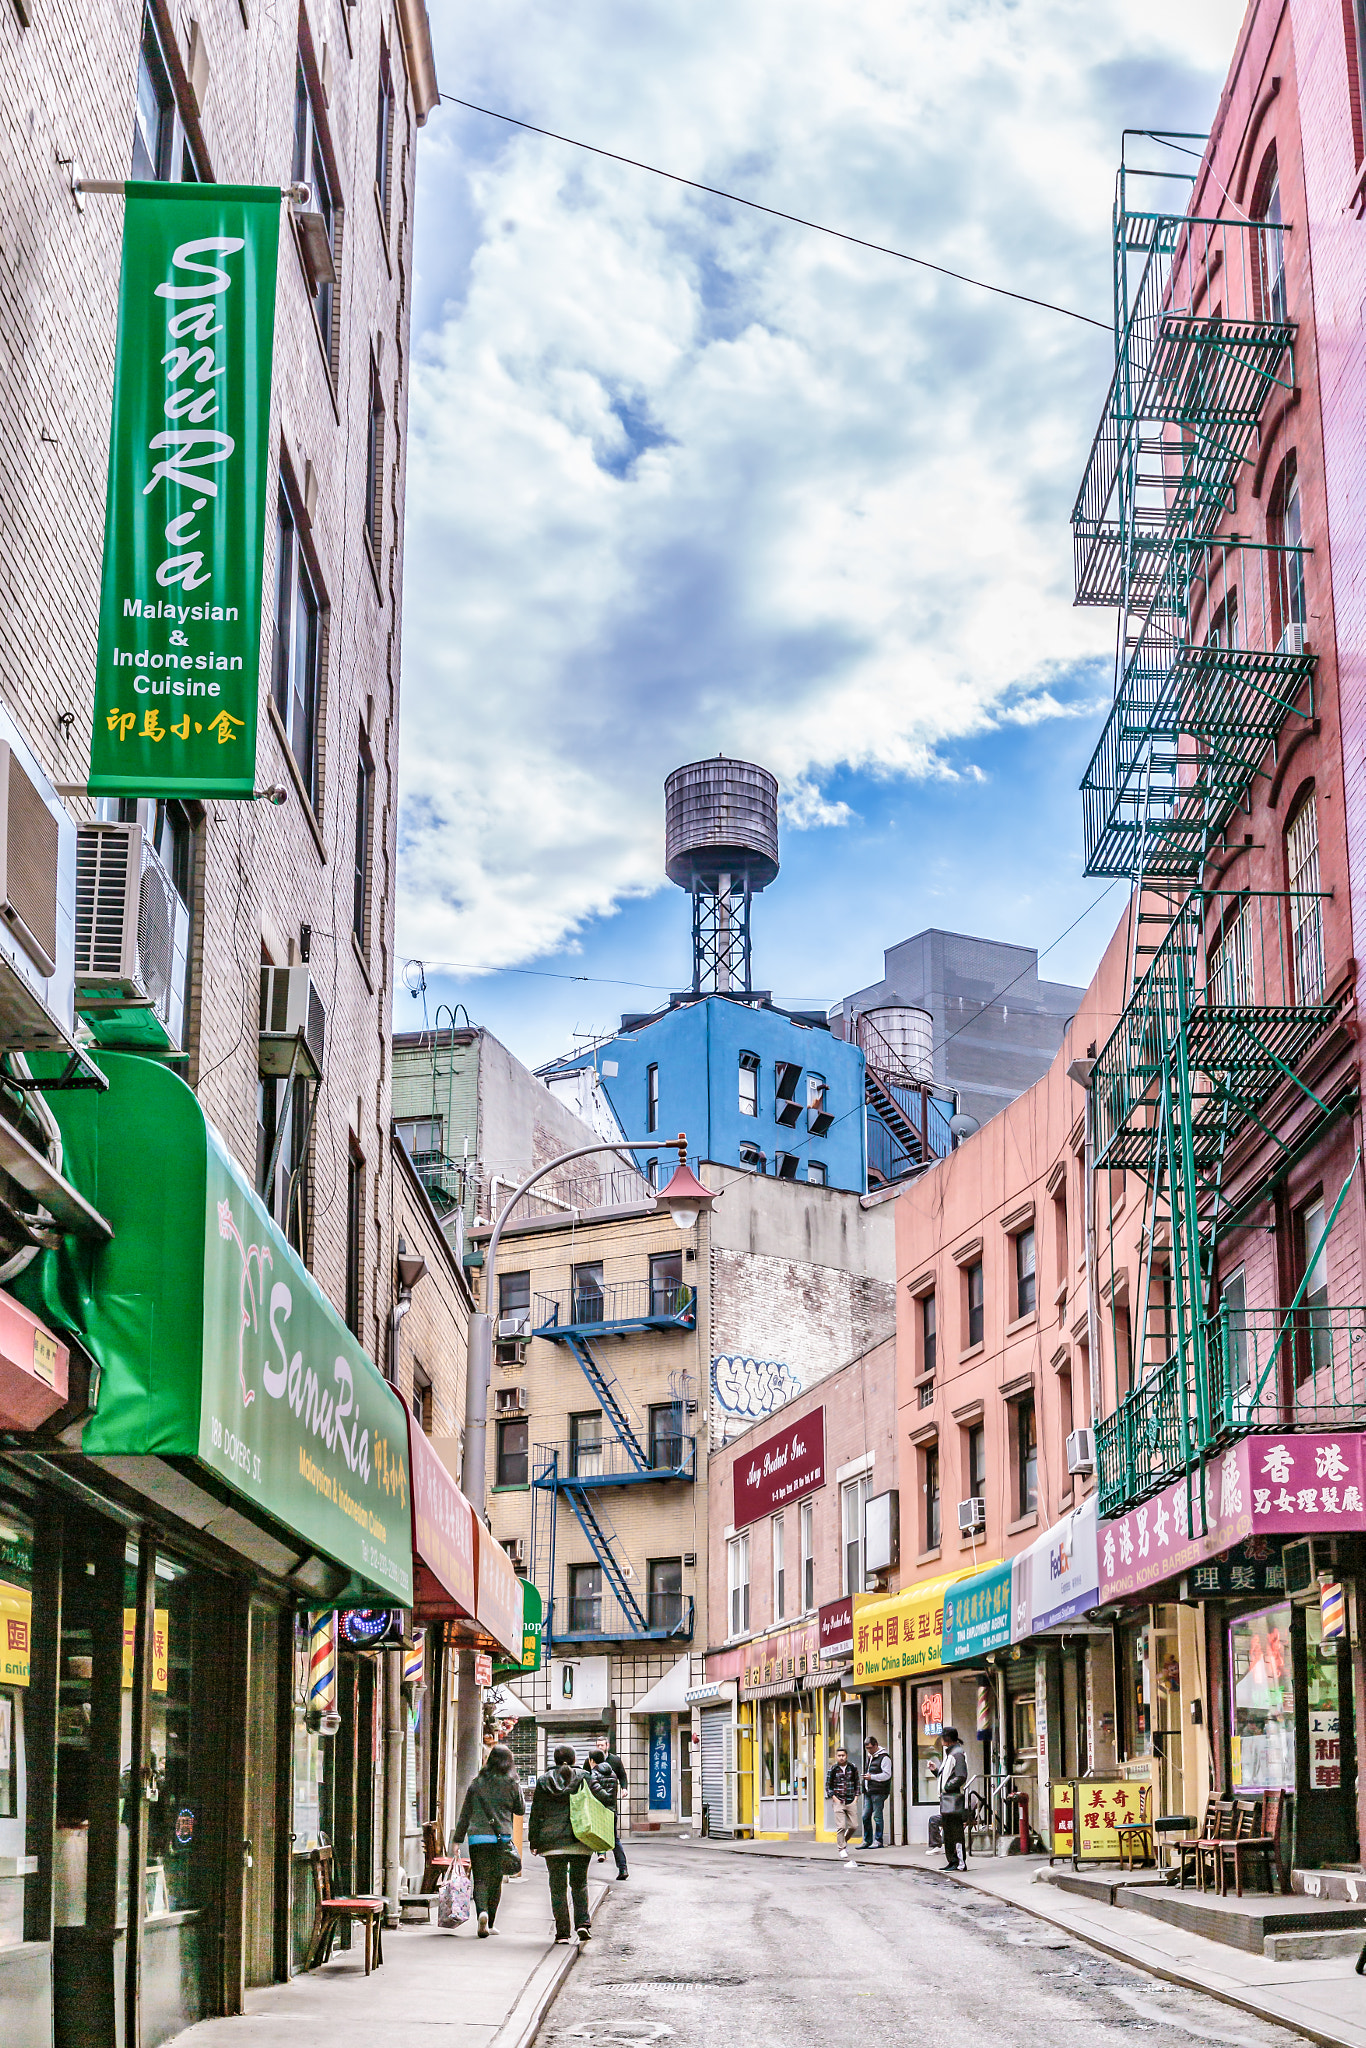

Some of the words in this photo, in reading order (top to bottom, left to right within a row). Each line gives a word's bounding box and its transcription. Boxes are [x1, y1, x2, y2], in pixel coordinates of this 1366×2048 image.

[142, 236, 246, 592] SanuRia
[123, 598, 239, 625] Malaysian
[168, 629, 190, 647] &
[113, 647, 243, 671] Indonesian
[133, 675, 221, 697] Cuisine
[106, 707, 245, 745] 印馬小食
[263, 1281, 371, 1485] SanuRia
[223, 1428, 251, 1475] DOYERS
[1260, 1443, 1350, 1484] 香港
[1252, 1486, 1364, 1514] 男女理髮廳
[1050, 1542, 1070, 1581] FedEx
[1110, 1576, 1134, 1594] HONG
[1136, 1565, 1160, 1584] KONG
[1162, 1543, 1200, 1574] BARBER
[857, 1607, 944, 1655] 新中國髮型屋
[865, 1660, 880, 1675] New
[881, 1655, 900, 1672] China
[902, 1650, 926, 1666] Beauty
[1088, 1789, 1129, 1809] 美奇
